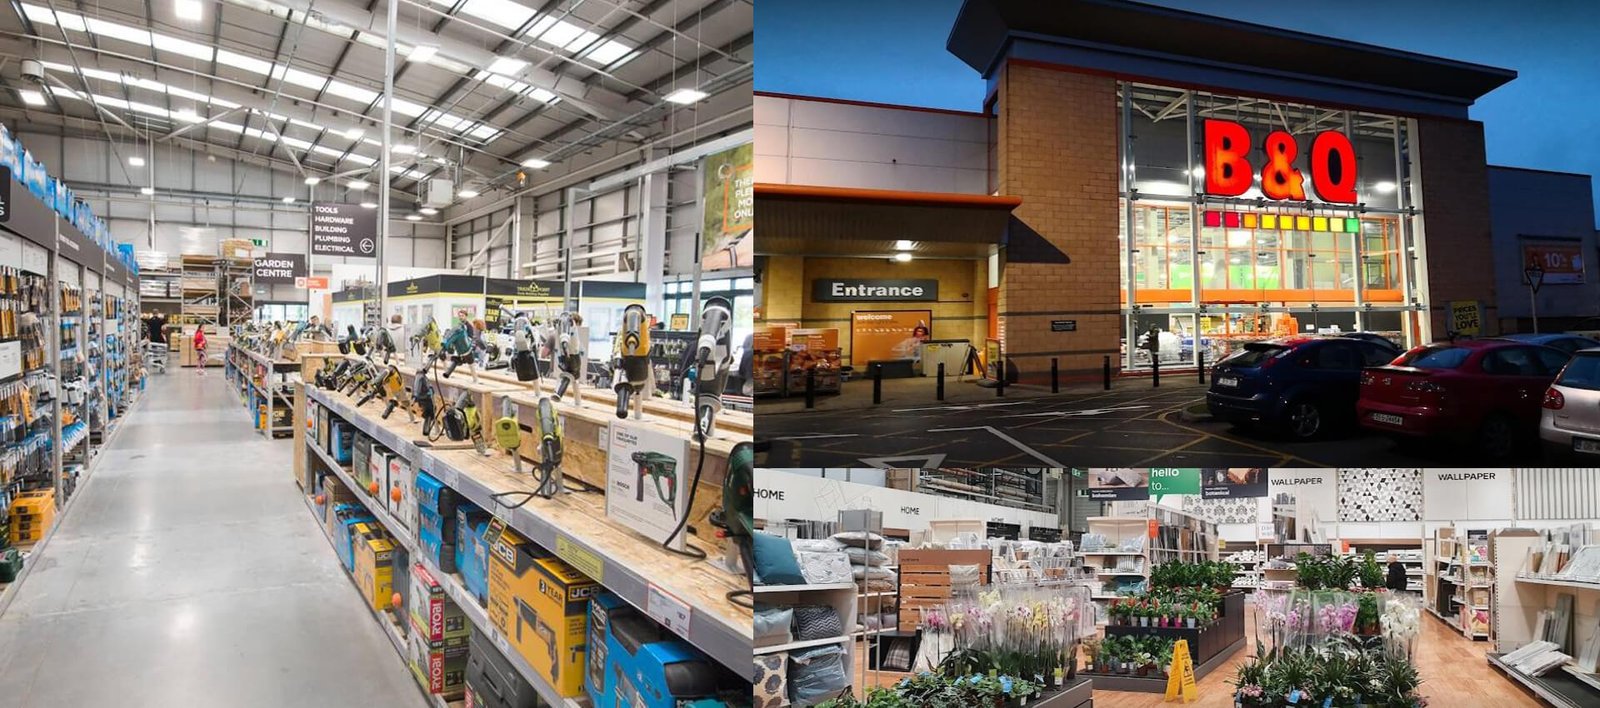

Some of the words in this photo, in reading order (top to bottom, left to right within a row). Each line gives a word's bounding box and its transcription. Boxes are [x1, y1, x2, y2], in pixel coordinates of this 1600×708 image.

[1204, 118, 1358, 205] B&Q
[315, 206, 339, 214] TOOLS
[315, 216, 354, 225] HARDWARE
[314, 225, 348, 234] BUILDING
[314, 235, 351, 243] PLUMBING
[314, 244, 355, 253] ELECTRICAL
[254, 259, 294, 268] GARDEN
[256, 269, 292, 278] CENTRE
[831, 282, 924, 297] Entrance
[1453, 305, 1477, 314] PRICES
[856, 313, 893, 321] welcome
[1455, 319, 1479, 330] LOVE
[1151, 467, 1180, 477] hello
[1271, 477, 1323, 486] WALLPAPER
[1438, 472, 1496, 482] WALLPAPER
[753, 487, 785, 500] HOME
[901, 506, 920, 515] HOME
[432, 603, 443, 635] RYOBI
[432, 657, 443, 690] RYOBI
